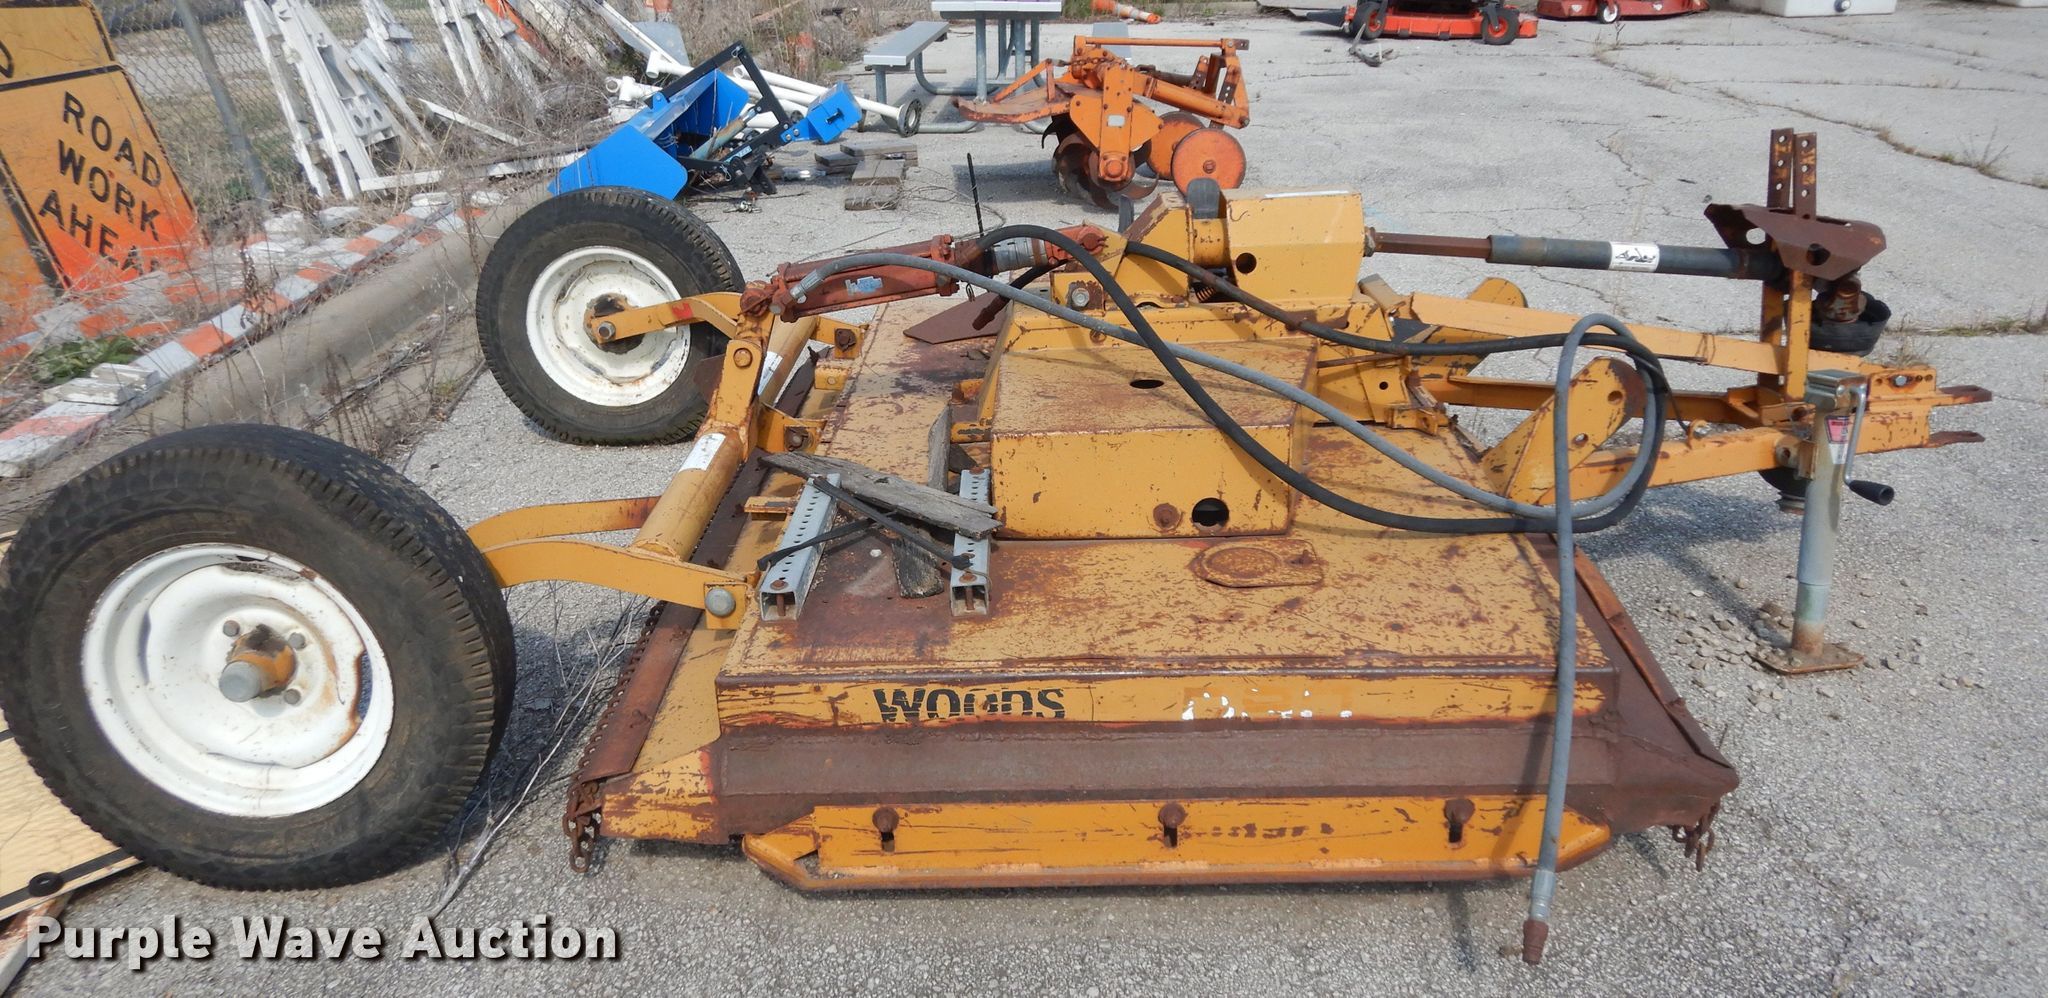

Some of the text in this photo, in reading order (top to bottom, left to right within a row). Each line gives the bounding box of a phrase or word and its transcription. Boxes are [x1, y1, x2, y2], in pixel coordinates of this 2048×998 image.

[62, 91, 162, 188] ROAD
[58, 139, 161, 242] WORK
[873, 688, 1066, 722] WOODS
